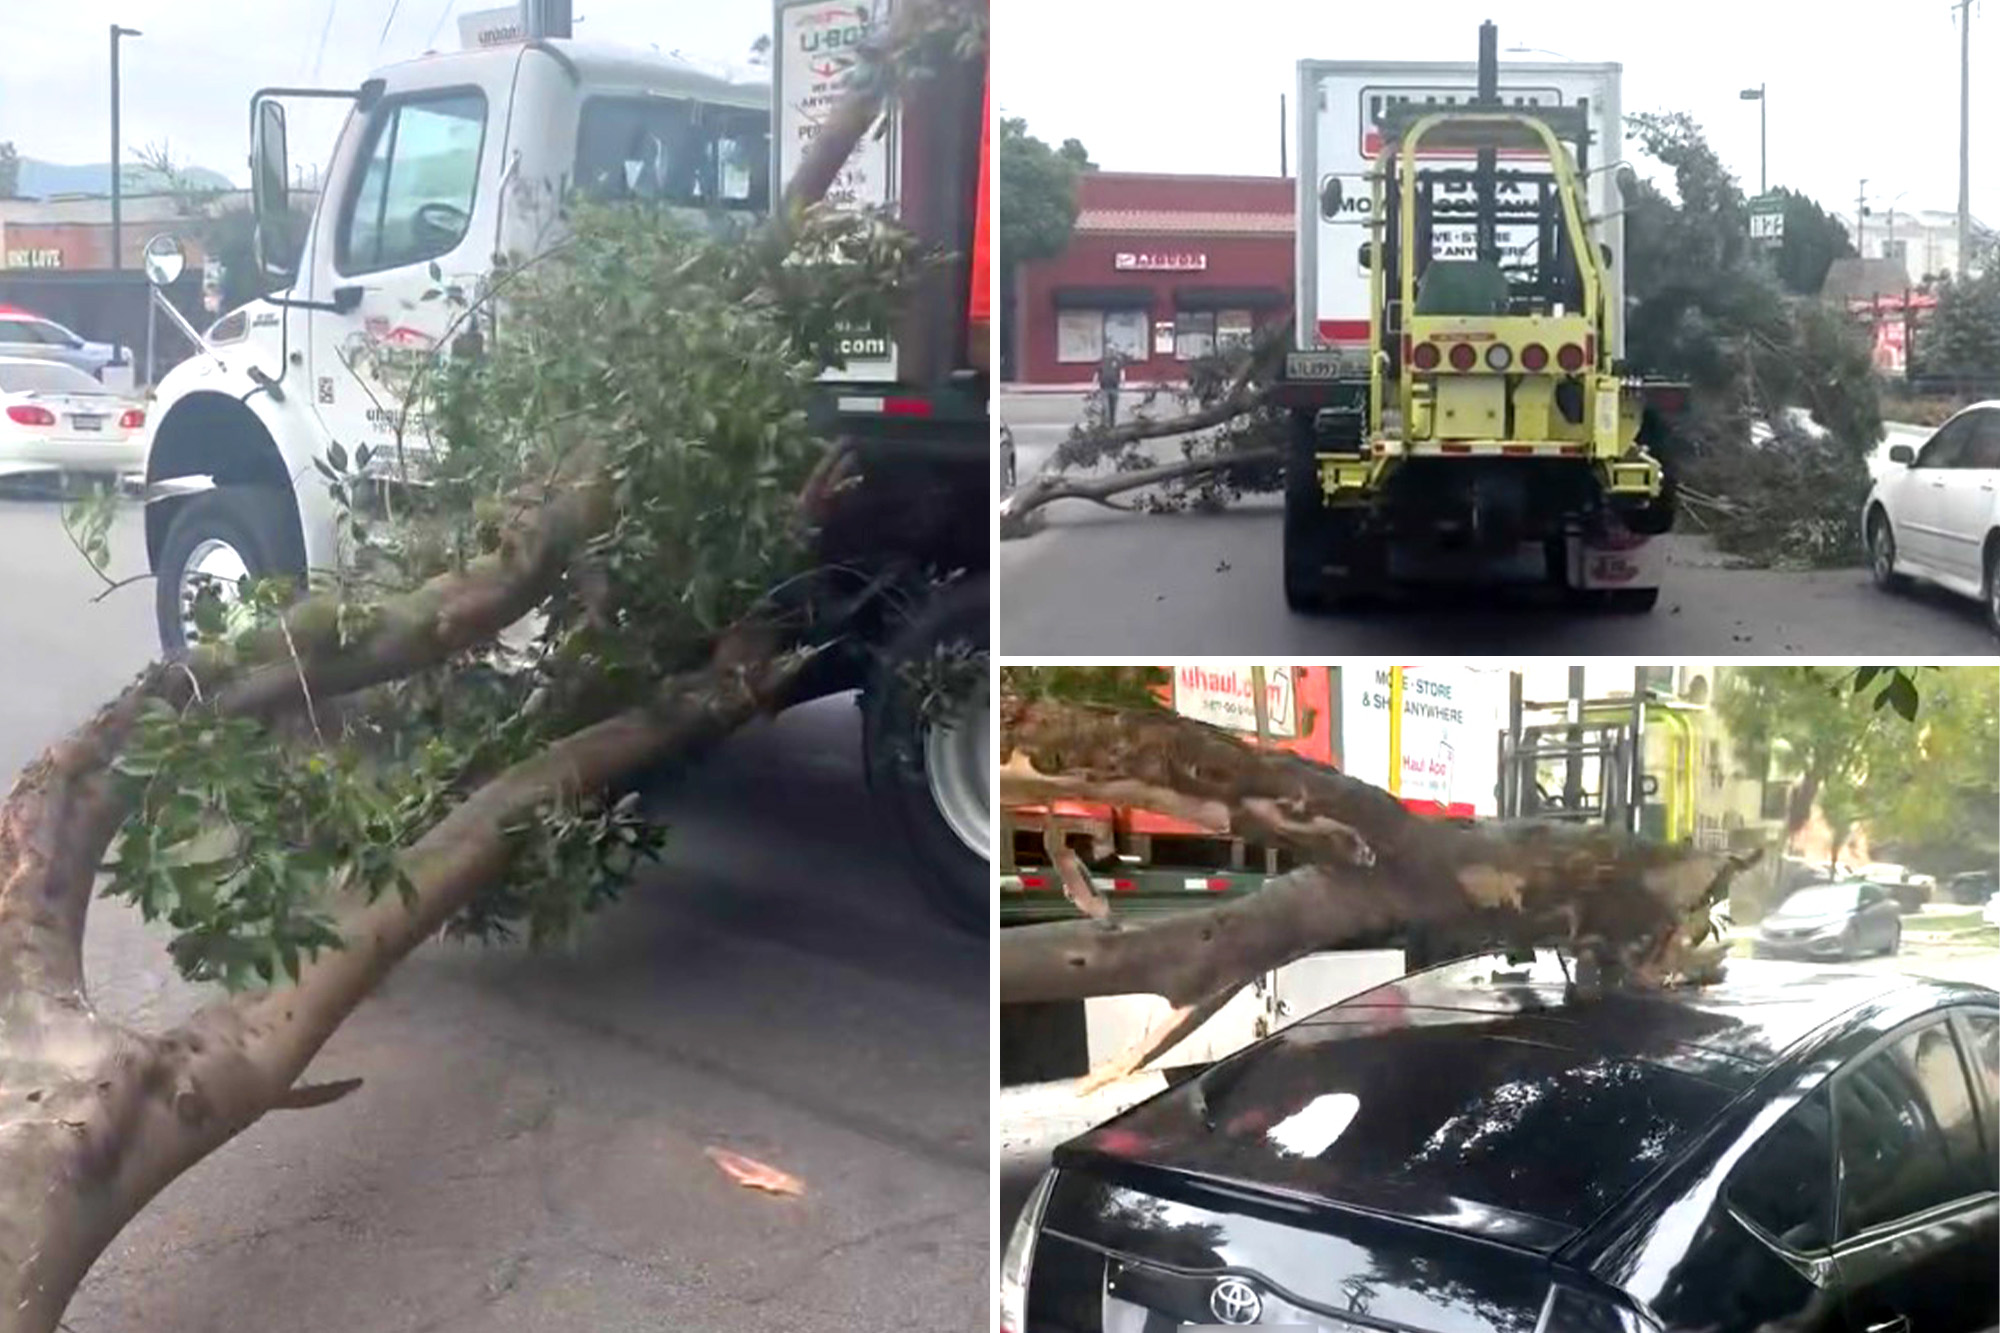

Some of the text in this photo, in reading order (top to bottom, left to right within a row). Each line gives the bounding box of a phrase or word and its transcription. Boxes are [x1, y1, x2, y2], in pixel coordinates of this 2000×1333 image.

[1181, 664, 1282, 707] uhaul.cm
[1415, 678, 1452, 700] STORE
[1403, 699, 1463, 725] ANYWHERE
